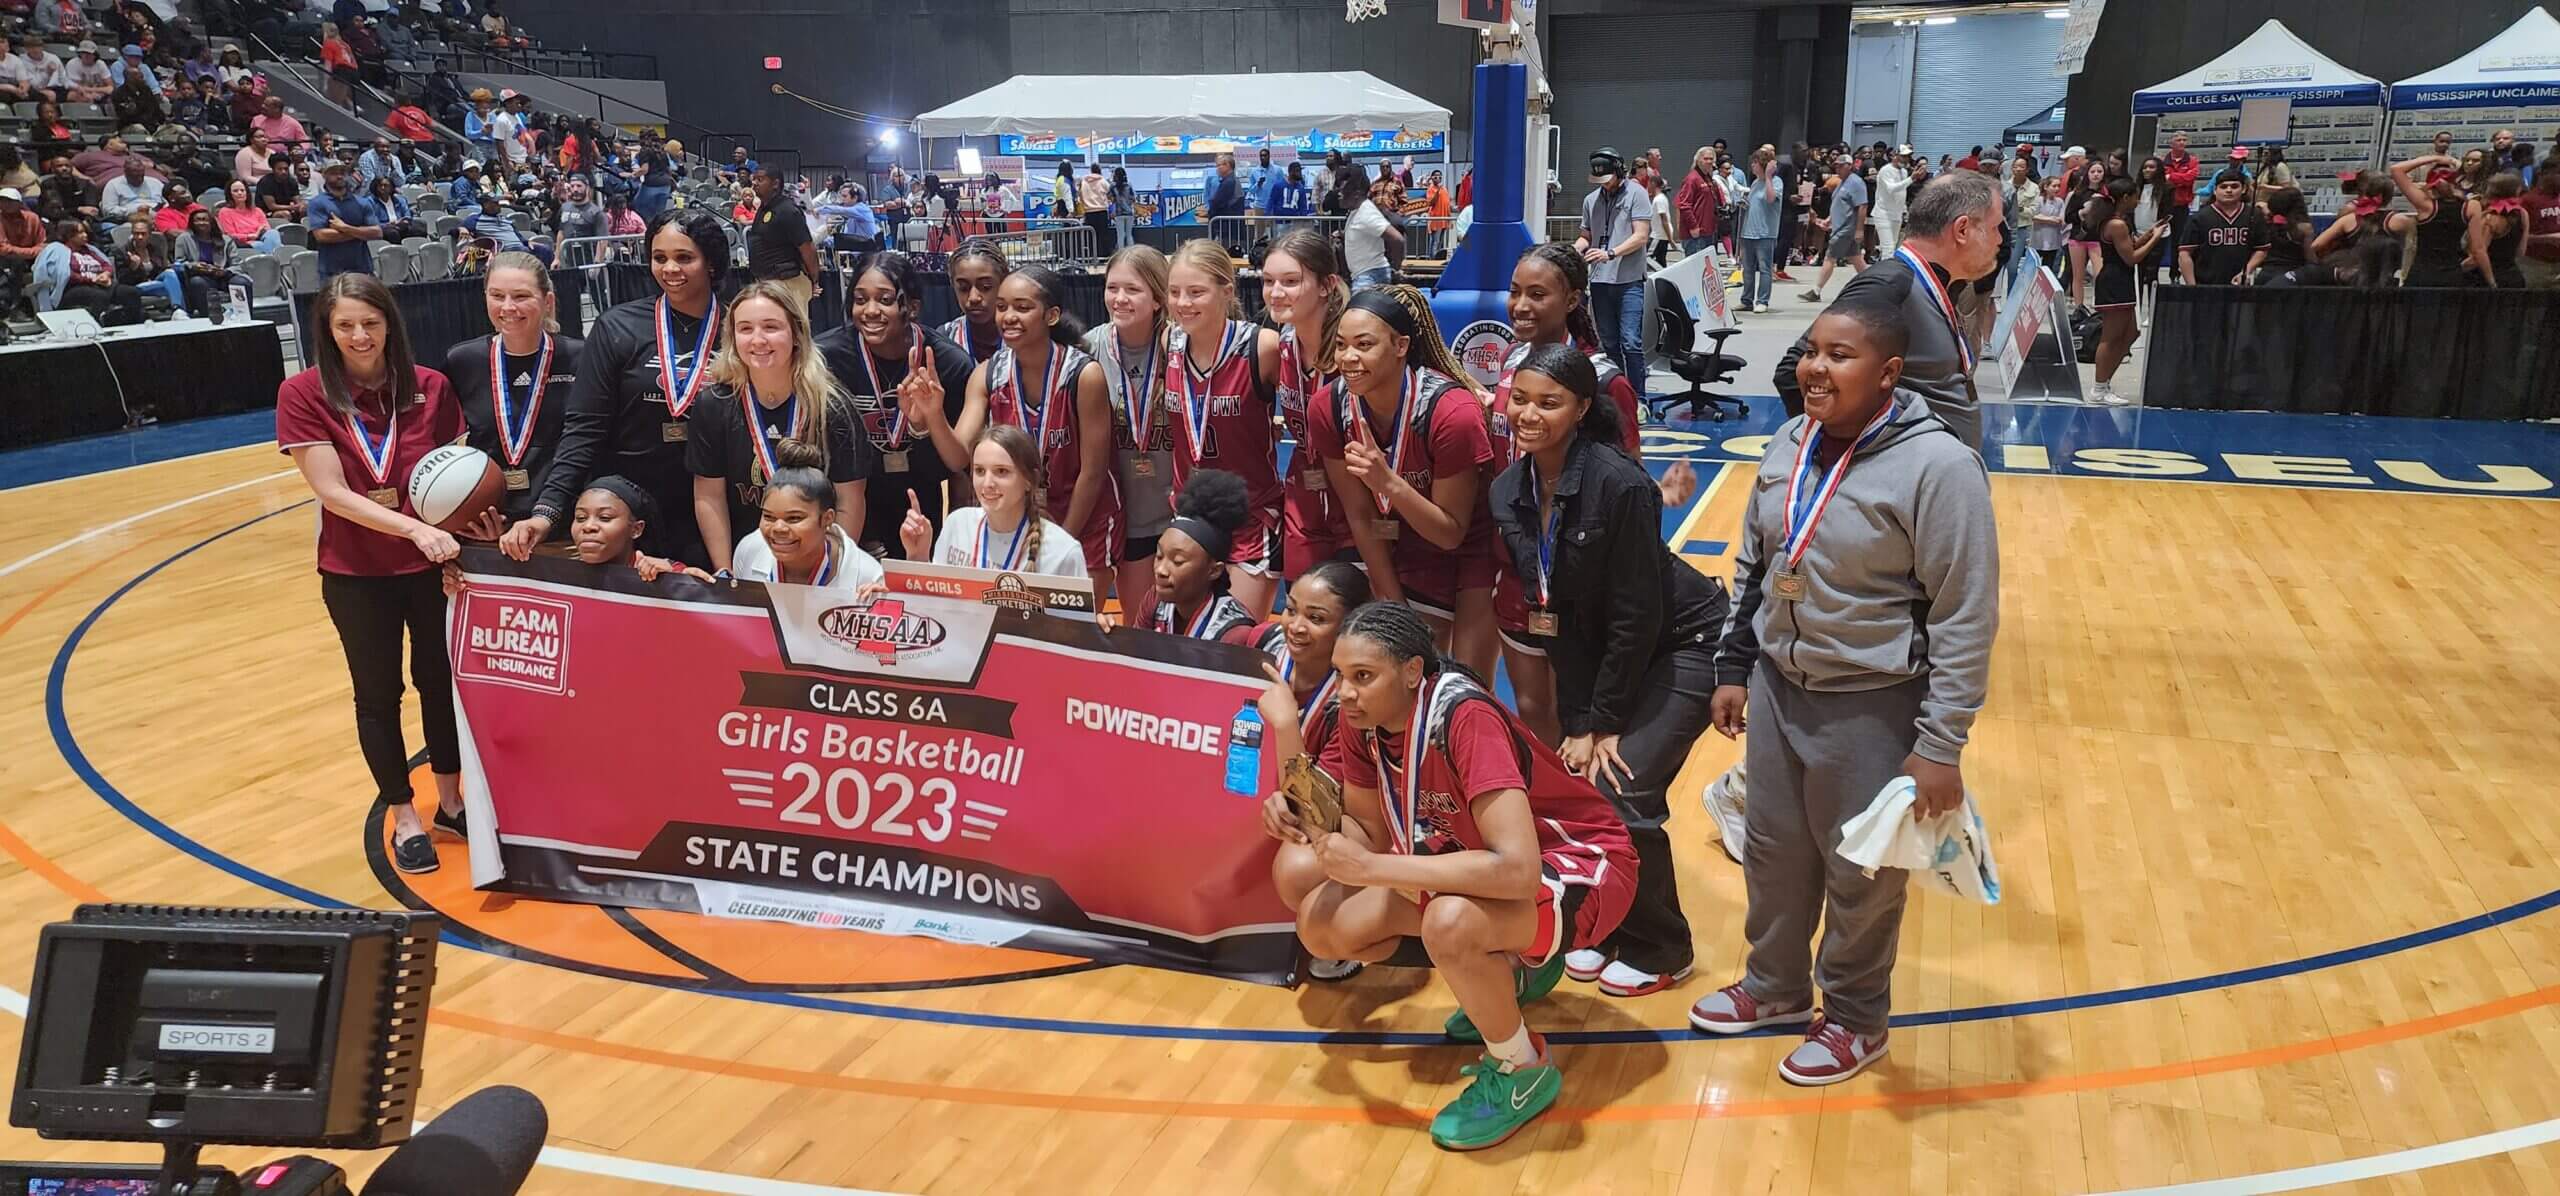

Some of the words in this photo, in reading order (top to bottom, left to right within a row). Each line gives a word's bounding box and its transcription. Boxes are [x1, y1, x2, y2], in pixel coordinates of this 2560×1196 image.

[2166, 94, 2218, 106] COLLEGE
[2416, 90, 2489, 102] MISSISSIPPI
[1010, 139, 1056, 151] SAUSAGE
[1324, 136, 1370, 148] SAUSAGE
[1379, 139, 1433, 149] TENDERS
[1164, 192, 1205, 221] HAMBU
[1283, 187, 1299, 209] LA
[2208, 227, 2249, 246] GHS
[1467, 350, 1500, 363] MHSA
[411, 450, 456, 496] Wilson
[905, 577, 922, 592] 6A
[926, 577, 962, 596] GIRLS
[1049, 592, 1085, 608] 2023
[500, 606, 559, 636] FARM
[832, 611, 930, 646] MHSAA
[471, 627, 559, 658] BUREAU
[487, 657, 556, 681] INSURANCE
[809, 683, 898, 717] CLASS
[908, 696, 948, 723] 6A
[1066, 697, 1222, 756] POWERADE
[717, 711, 810, 754] Girls
[821, 723, 1025, 786] Basketball
[779, 762, 957, 843] 2023
[685, 836, 800, 878] STATE
[811, 851, 1042, 911] CHAMPIONS
[167, 1030, 250, 1047] SPORTS
[255, 1032, 268, 1047] 2
